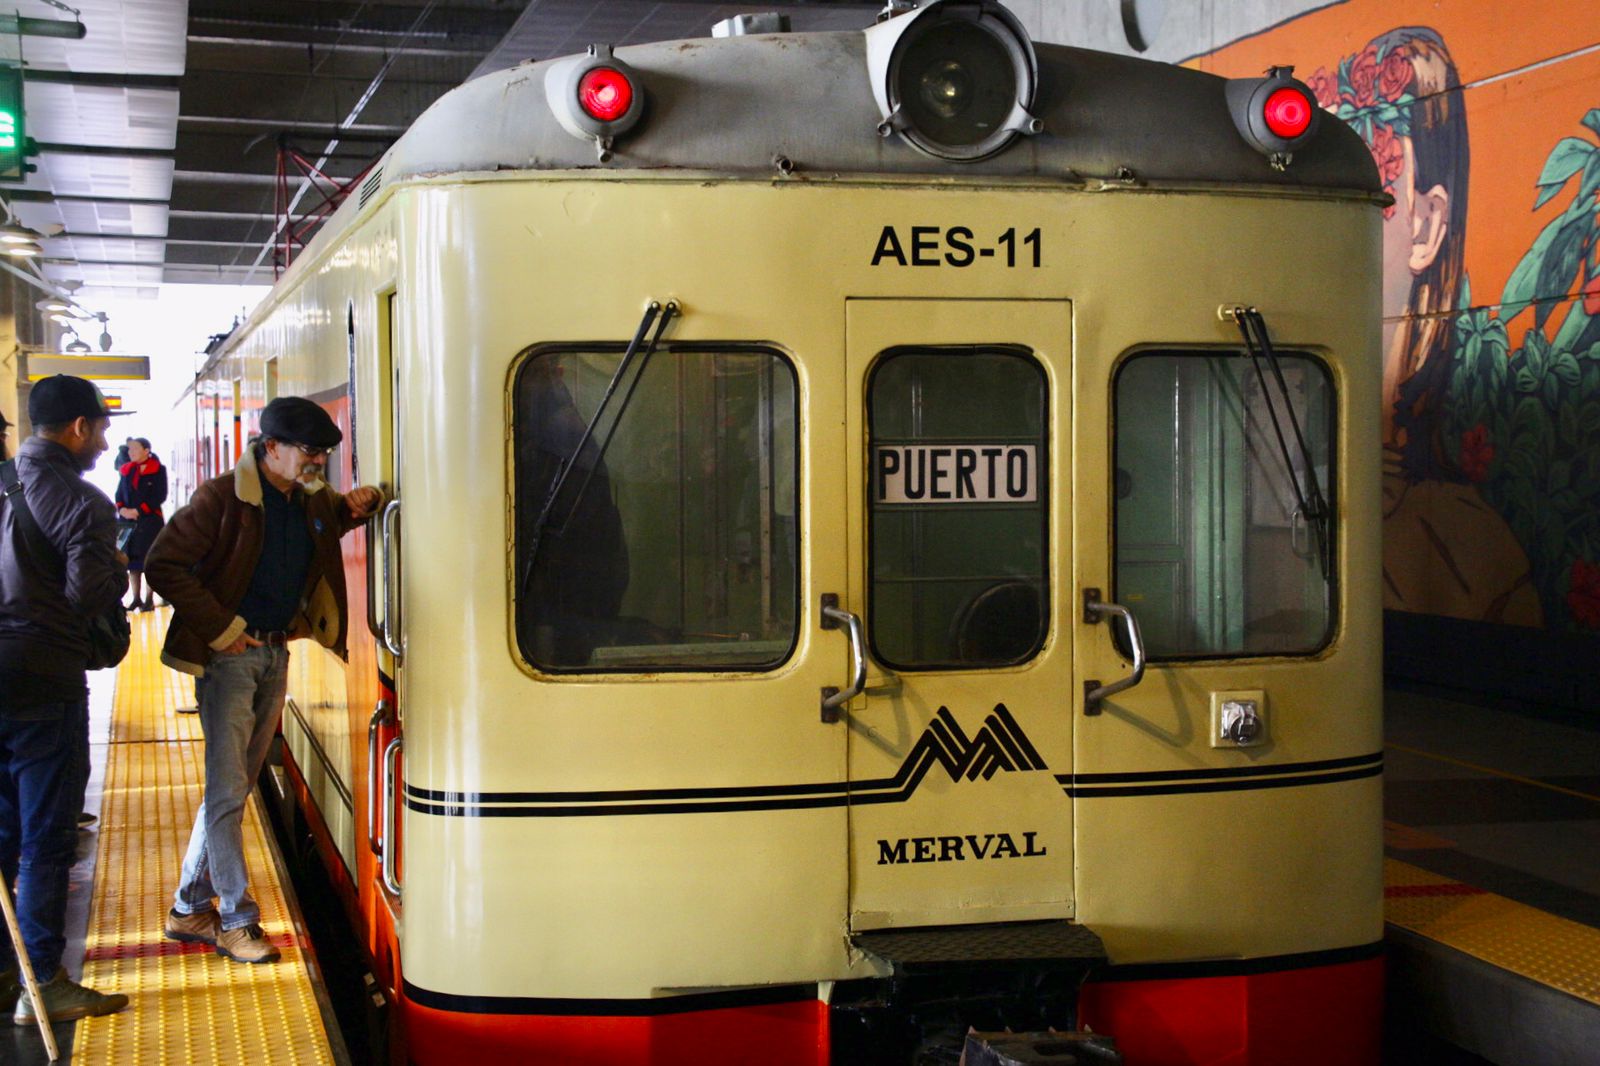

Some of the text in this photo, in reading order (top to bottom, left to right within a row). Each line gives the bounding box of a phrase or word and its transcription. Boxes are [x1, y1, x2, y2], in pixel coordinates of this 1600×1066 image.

[871, 226, 1041, 268] AES-11
[878, 448, 1029, 500] PUERTO
[877, 831, 1047, 865] MERVAL
